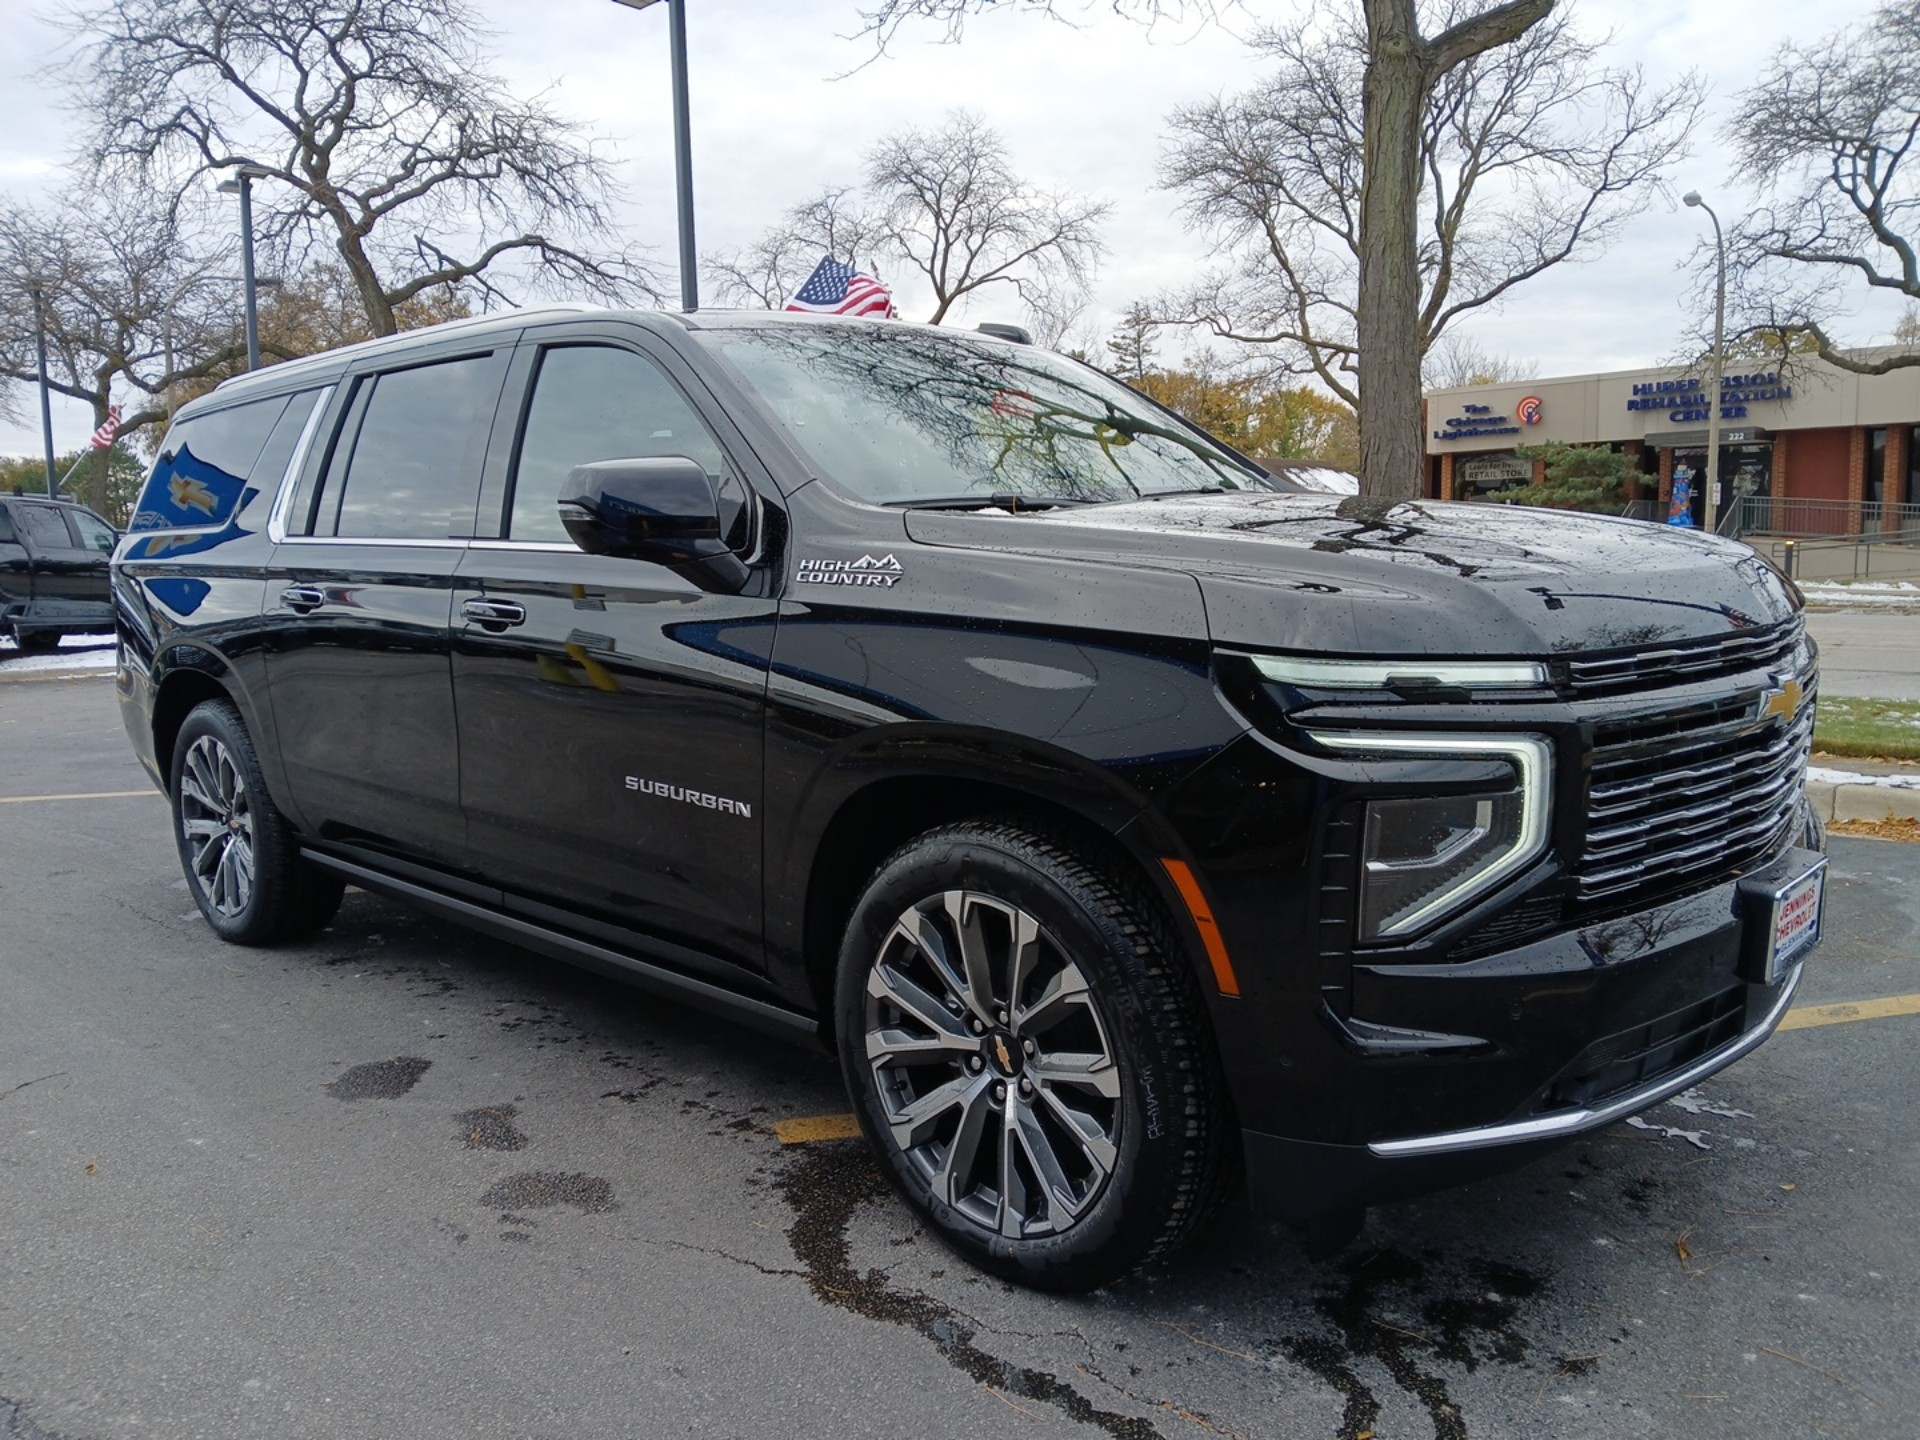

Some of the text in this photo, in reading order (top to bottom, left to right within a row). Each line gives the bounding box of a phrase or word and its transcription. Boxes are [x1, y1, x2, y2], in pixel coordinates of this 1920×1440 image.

[1632, 372, 1782, 396] HUBER ISION
[1627, 386, 1793, 412] REHABILTATION
[1462, 404, 1490, 414] The
[1669, 406, 1748, 422] CENER
[1446, 416, 1507, 427] Chicago
[1433, 427, 1520, 440] Lighthouse
[1468, 469, 1528, 479] RETAIL STORE
[799, 559, 852, 571] HIGH
[796, 571, 902, 587] COUNTRY
[625, 775, 752, 818] SUBURBAN
